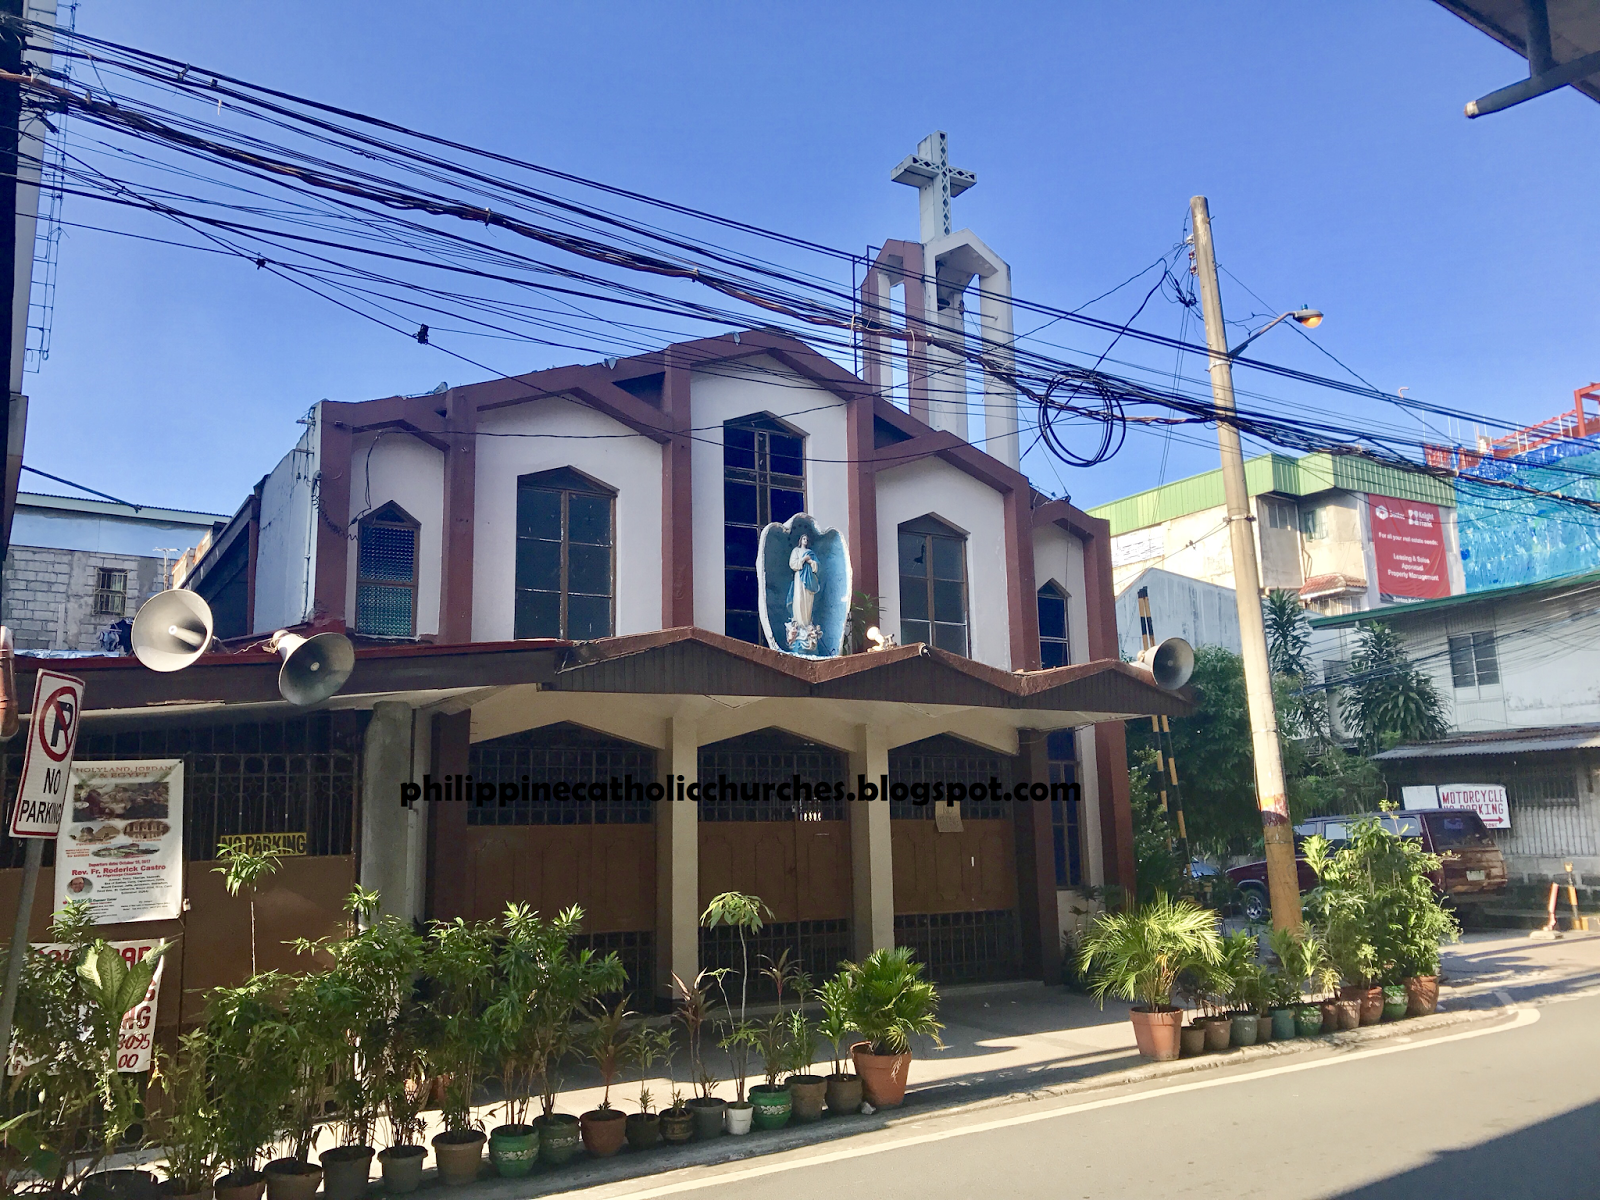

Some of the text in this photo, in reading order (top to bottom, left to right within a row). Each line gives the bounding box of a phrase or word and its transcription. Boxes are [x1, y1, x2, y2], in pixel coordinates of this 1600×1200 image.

[1419, 512, 1434, 521] Knight
[1393, 553, 1412, 563] Leasing
[1417, 556, 1430, 564] Sales
[1401, 563, 1424, 571] Appraisal
[1387, 569, 1439, 581] Property Management
[43, 767, 61, 795] NO
[1442, 789, 1503, 804] MOTORCYCLE
[19, 799, 62, 825] PARKING
[221, 834, 307, 856] NO PARKING
[103, 866, 138, 874] Roderick
